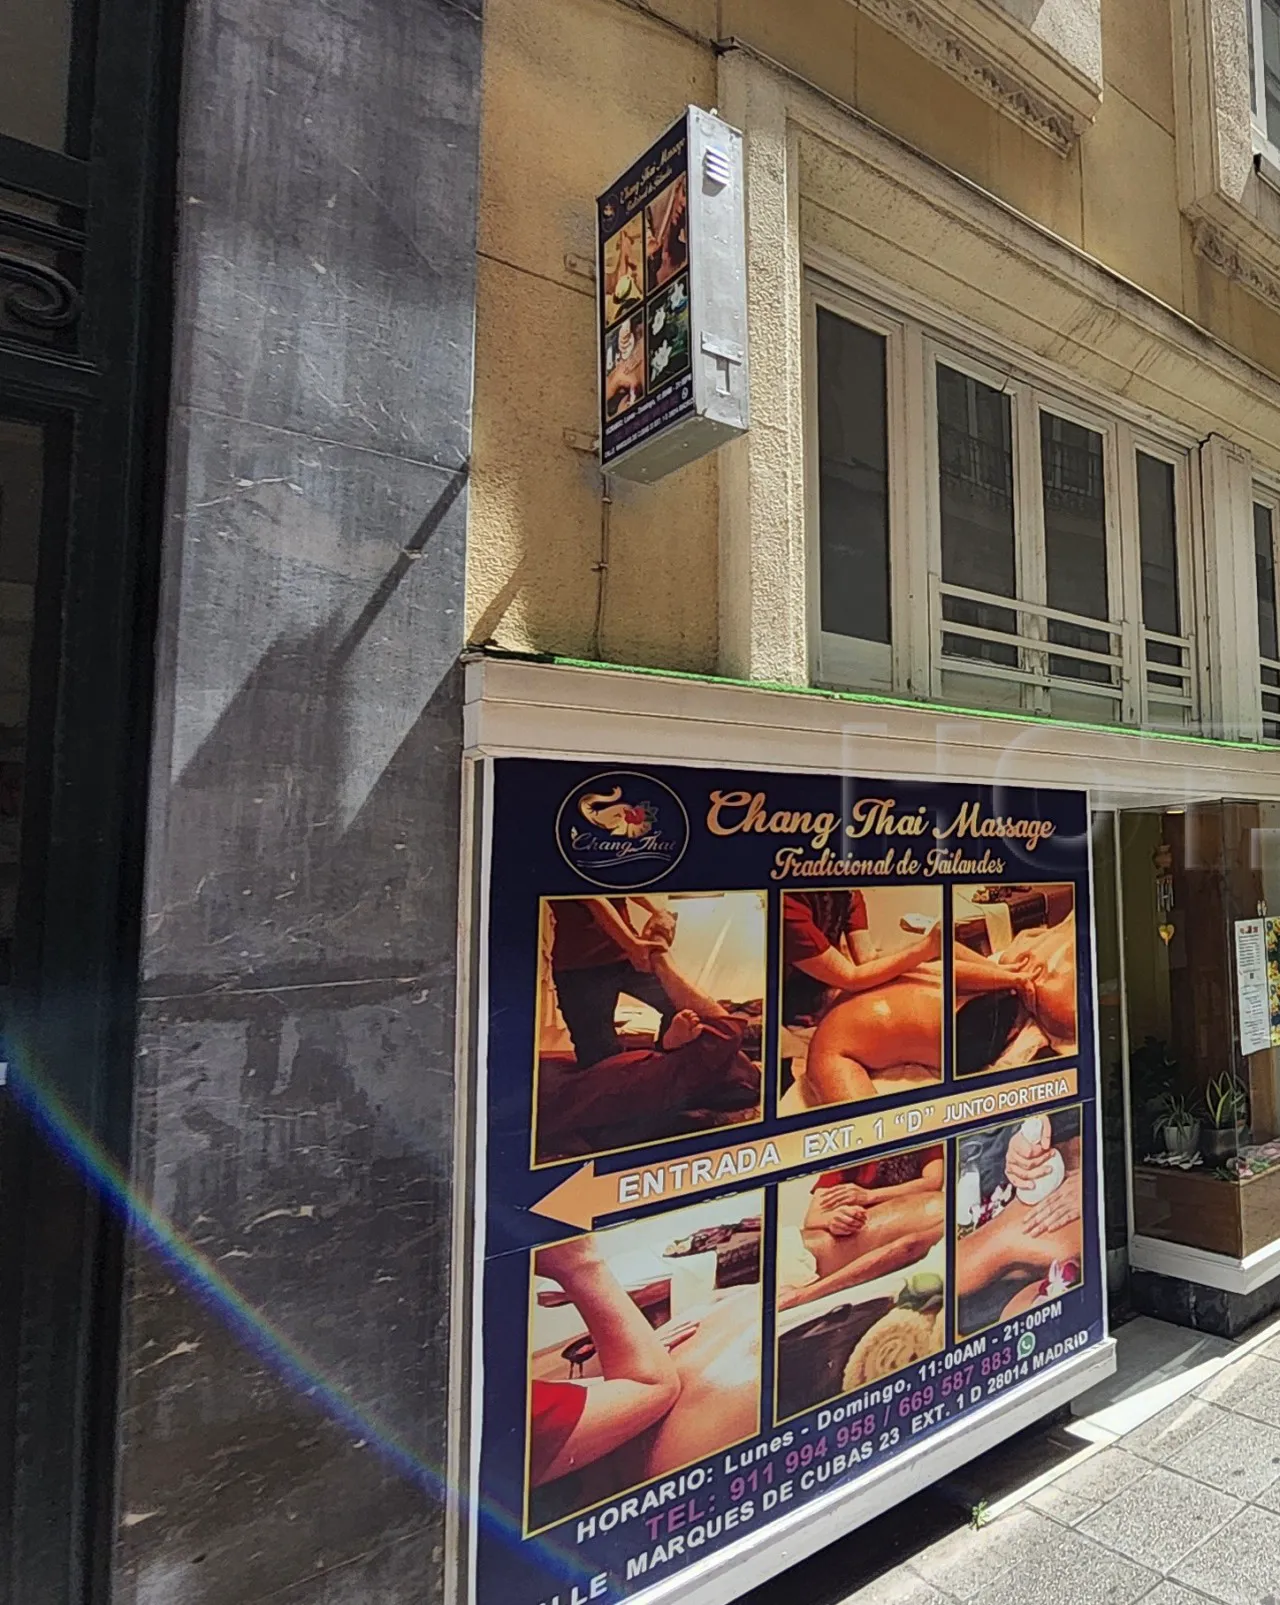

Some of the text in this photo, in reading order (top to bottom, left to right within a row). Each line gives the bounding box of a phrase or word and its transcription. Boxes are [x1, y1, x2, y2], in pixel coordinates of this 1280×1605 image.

[571, 831, 677, 858] Chang Thai
[706, 790, 1056, 850] Chang Thai Massage
[770, 847, 1006, 880] Tradicional de Tailandes
[619, 1142, 781, 1204] ENTRADA
[803, 1125, 863, 1159] EXT.
[874, 1118, 885, 1141] 1
[943, 1095, 996, 1124] JUNTO
[998, 1078, 1069, 1109] PORTERIA
[576, 1467, 714, 1544] HORARIO:
[724, 1430, 794, 1475] Lunes
[817, 1379, 912, 1431] Domingo,
[918, 1336, 986, 1382] 11:00AM
[1003, 1300, 1062, 1343] 21:00PM
[626, 1500, 755, 1581] MARQUES
[762, 1480, 794, 1512] DE
[800, 1441, 874, 1492] CUBAS
[878, 1427, 900, 1452] 23
[911, 1403, 951, 1435] EXT.
[956, 1391, 964, 1410] 1
[970, 1385, 982, 1404] D
[987, 1360, 1029, 1395] 28014
[1032, 1330, 1089, 1371] MADRID
[645, 1494, 717, 1542] TEL:
[729, 1462, 774, 1502] 911
[785, 1435, 829, 1474] 994
[835, 1413, 876, 1449] 958
[898, 1385, 934, 1418] 669
[940, 1364, 975, 1398] 587
[980, 1346, 1013, 1377] 883
